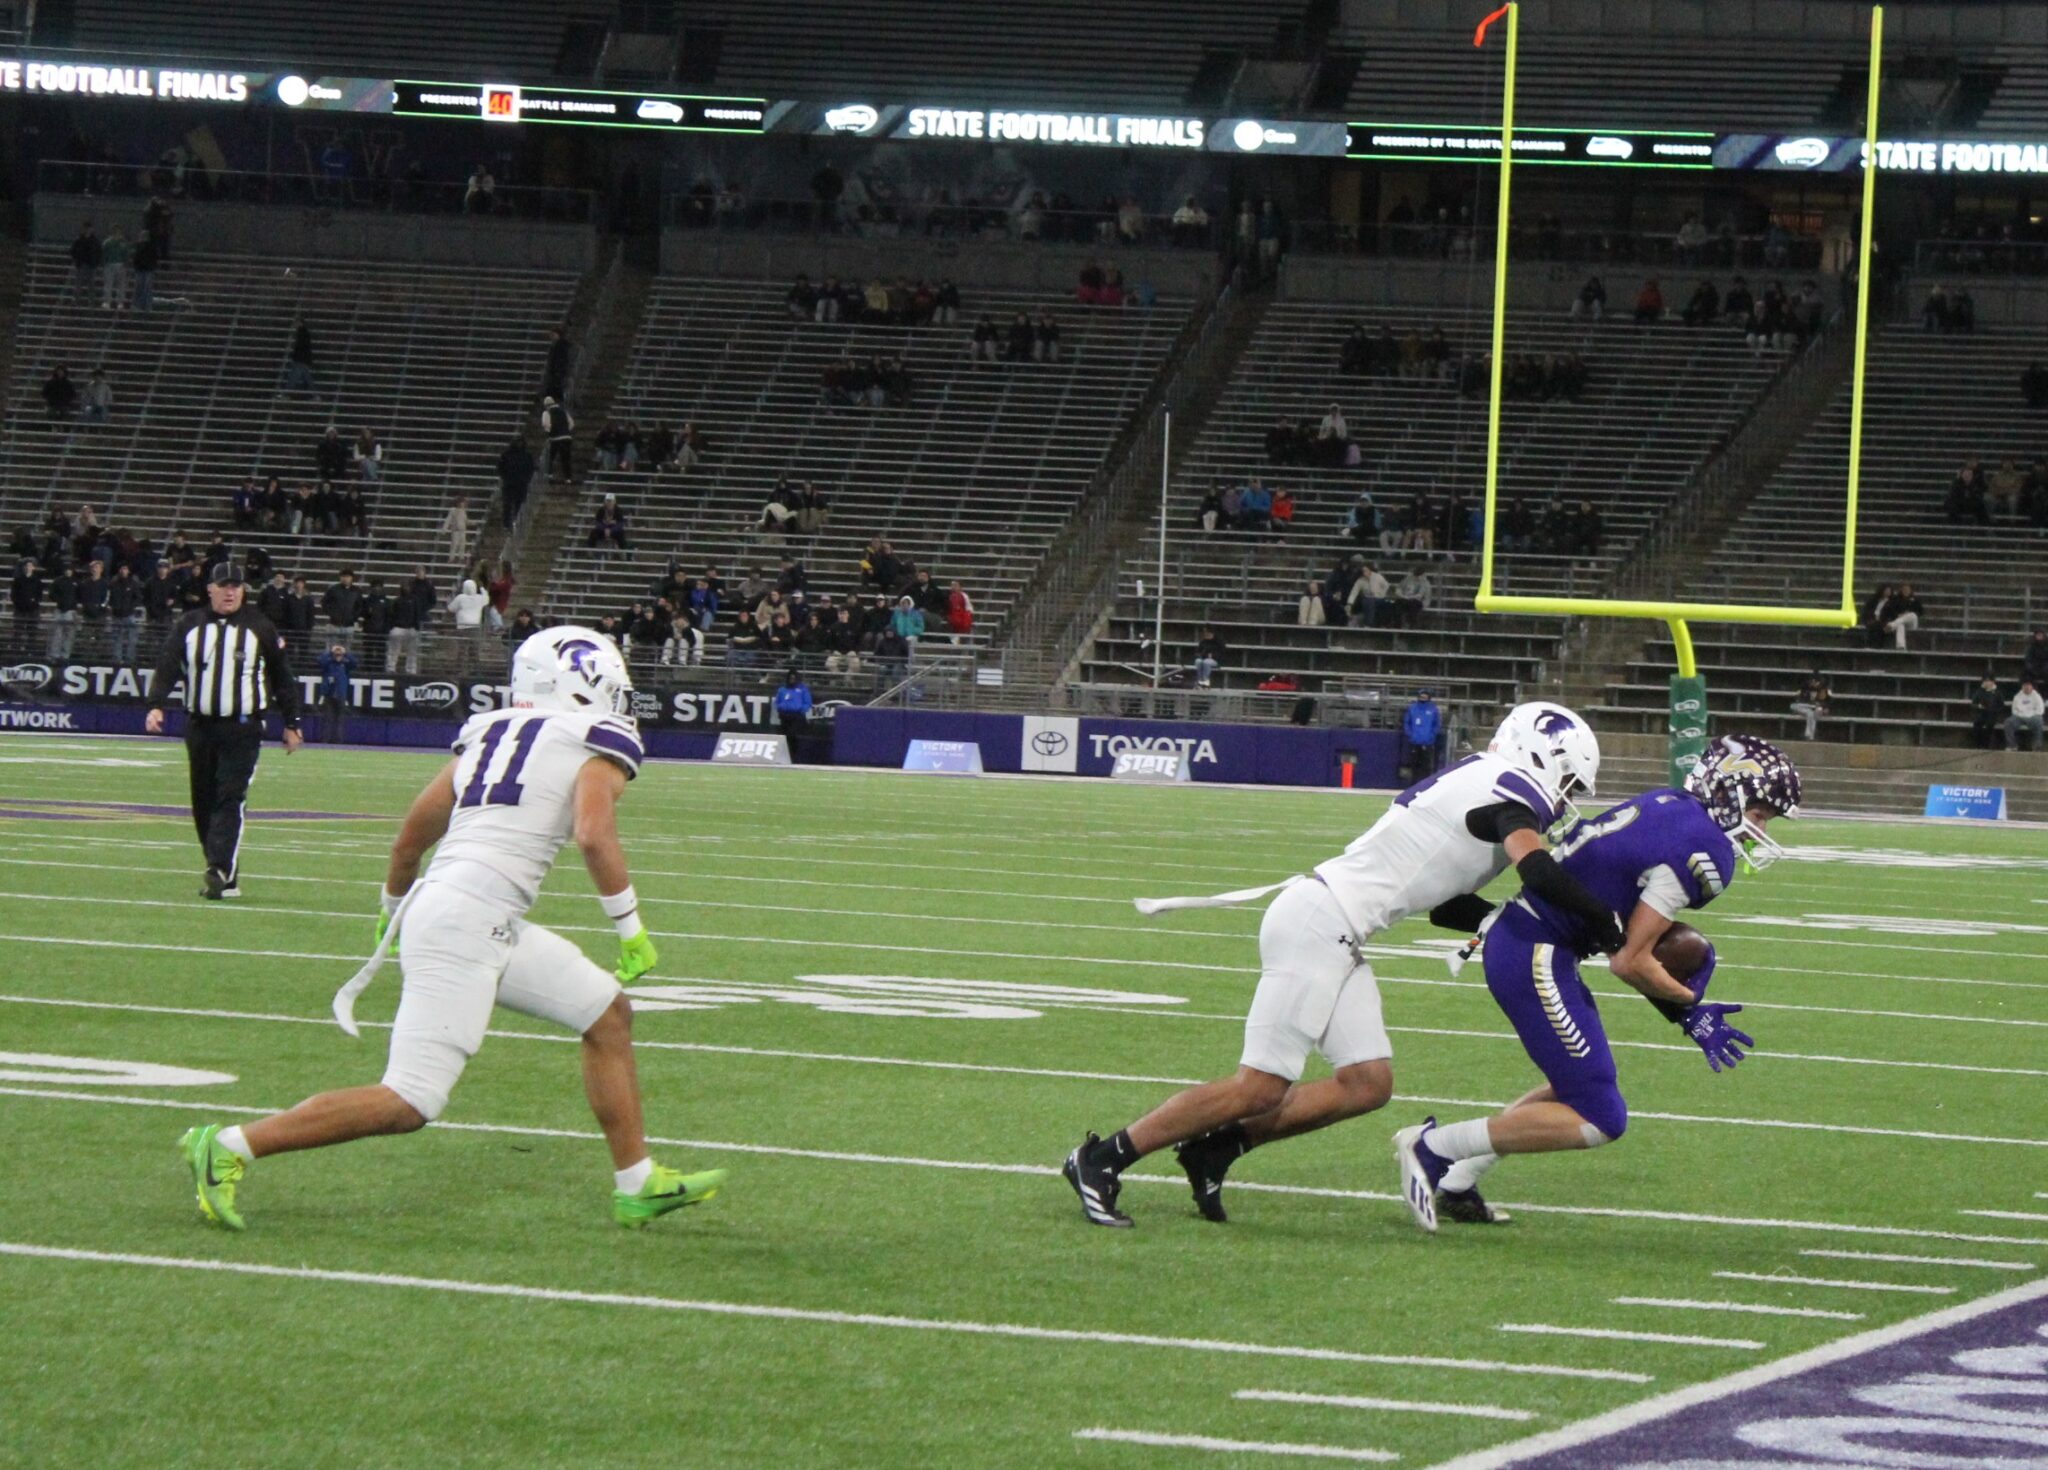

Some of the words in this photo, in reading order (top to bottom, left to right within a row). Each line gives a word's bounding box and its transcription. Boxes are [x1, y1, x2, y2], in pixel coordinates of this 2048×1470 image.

[27, 63, 152, 96] FOOTBALL
[159, 70, 247, 101] FINALS
[420, 93, 478, 106] PRESENTED
[519, 99, 559, 111] EATTLE
[704, 109, 762, 120] PRESENTED
[909, 108, 983, 137] STATE
[989, 111, 1112, 144] FOOTBALL
[1117, 118, 1204, 147] FINALS
[1372, 136, 1429, 148] PRESENTED
[1467, 138, 1504, 150] SEATTL
[1653, 144, 1711, 156] PRESENTED
[631, 700, 663, 711] Credit
[716, 738, 779, 761] STATE
[921, 742, 965, 752] VICTORY
[1089, 734, 1218, 763] TOYOTA
[459, 717, 548, 808] 11
[1115, 753, 1180, 778] STATE
[1942, 787, 1990, 798] VICTORY
